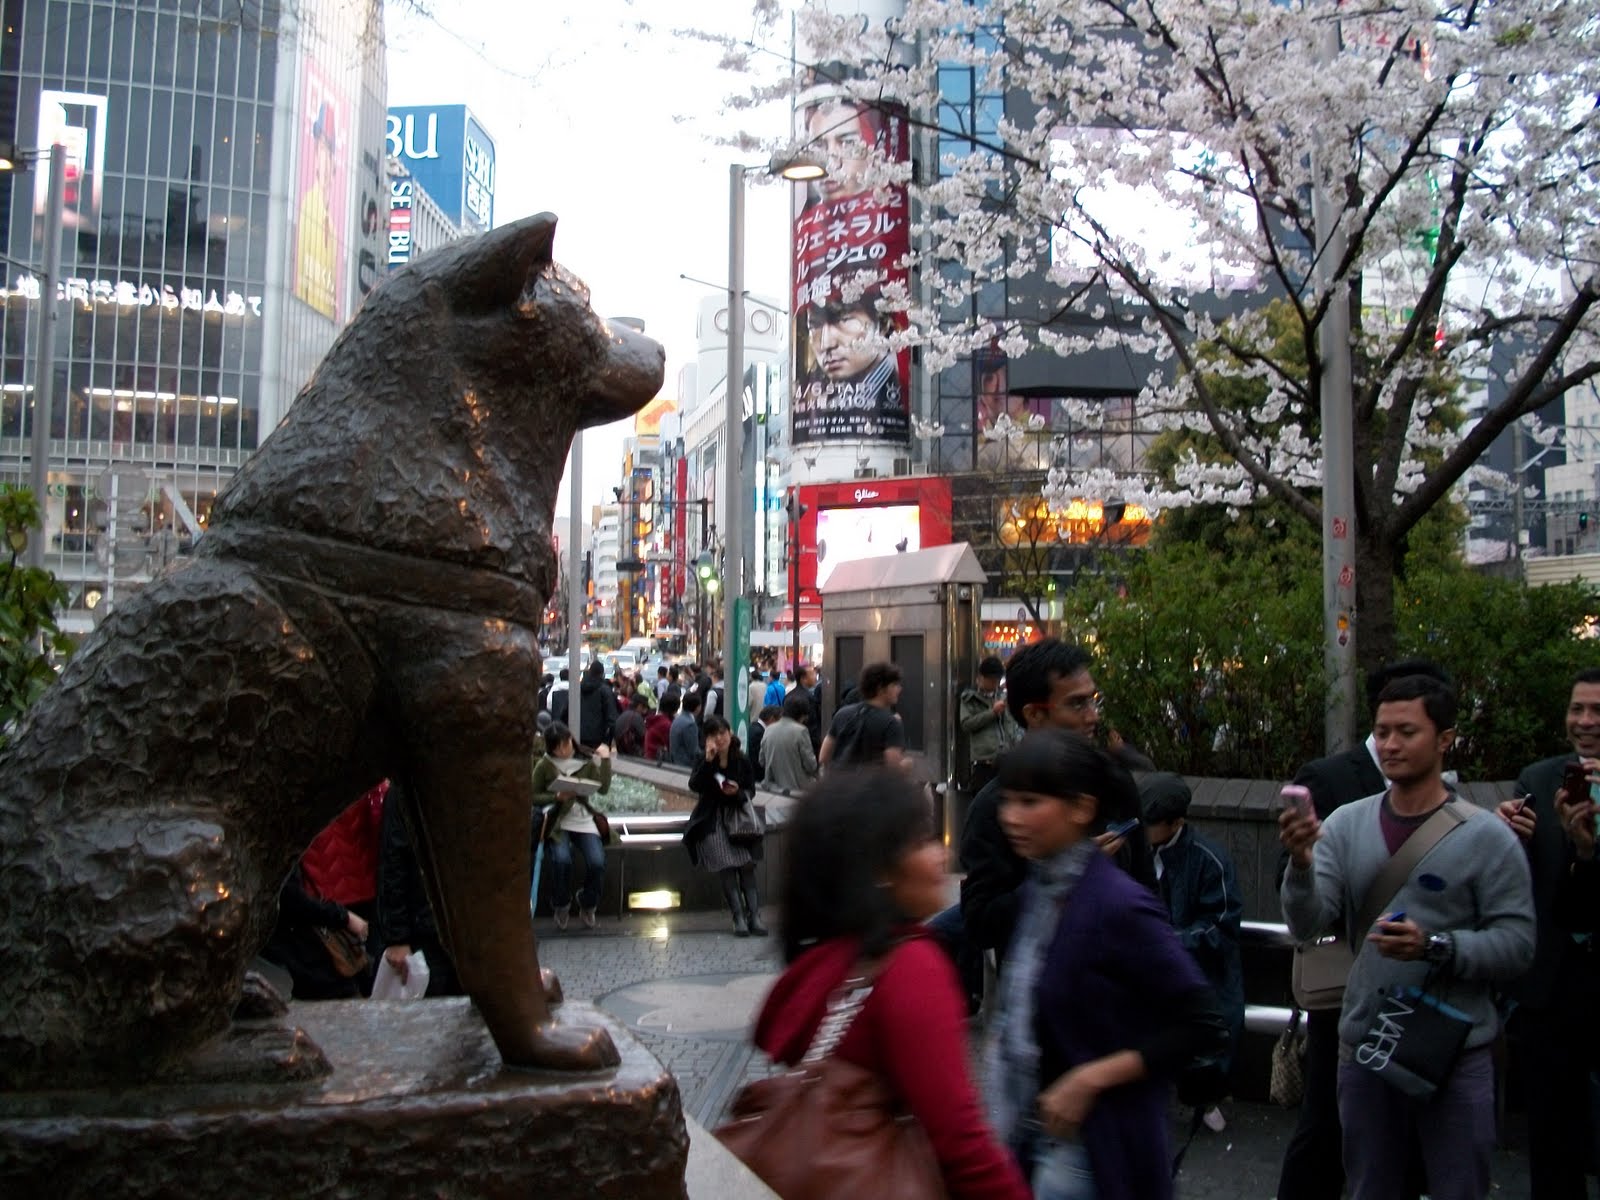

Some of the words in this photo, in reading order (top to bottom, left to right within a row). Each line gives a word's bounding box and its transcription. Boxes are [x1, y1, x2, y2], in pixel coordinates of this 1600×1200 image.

[388, 180, 413, 264] SEIBU
[1122, 294, 1190, 307] Panaoic
[854, 488, 880, 503] Glico
